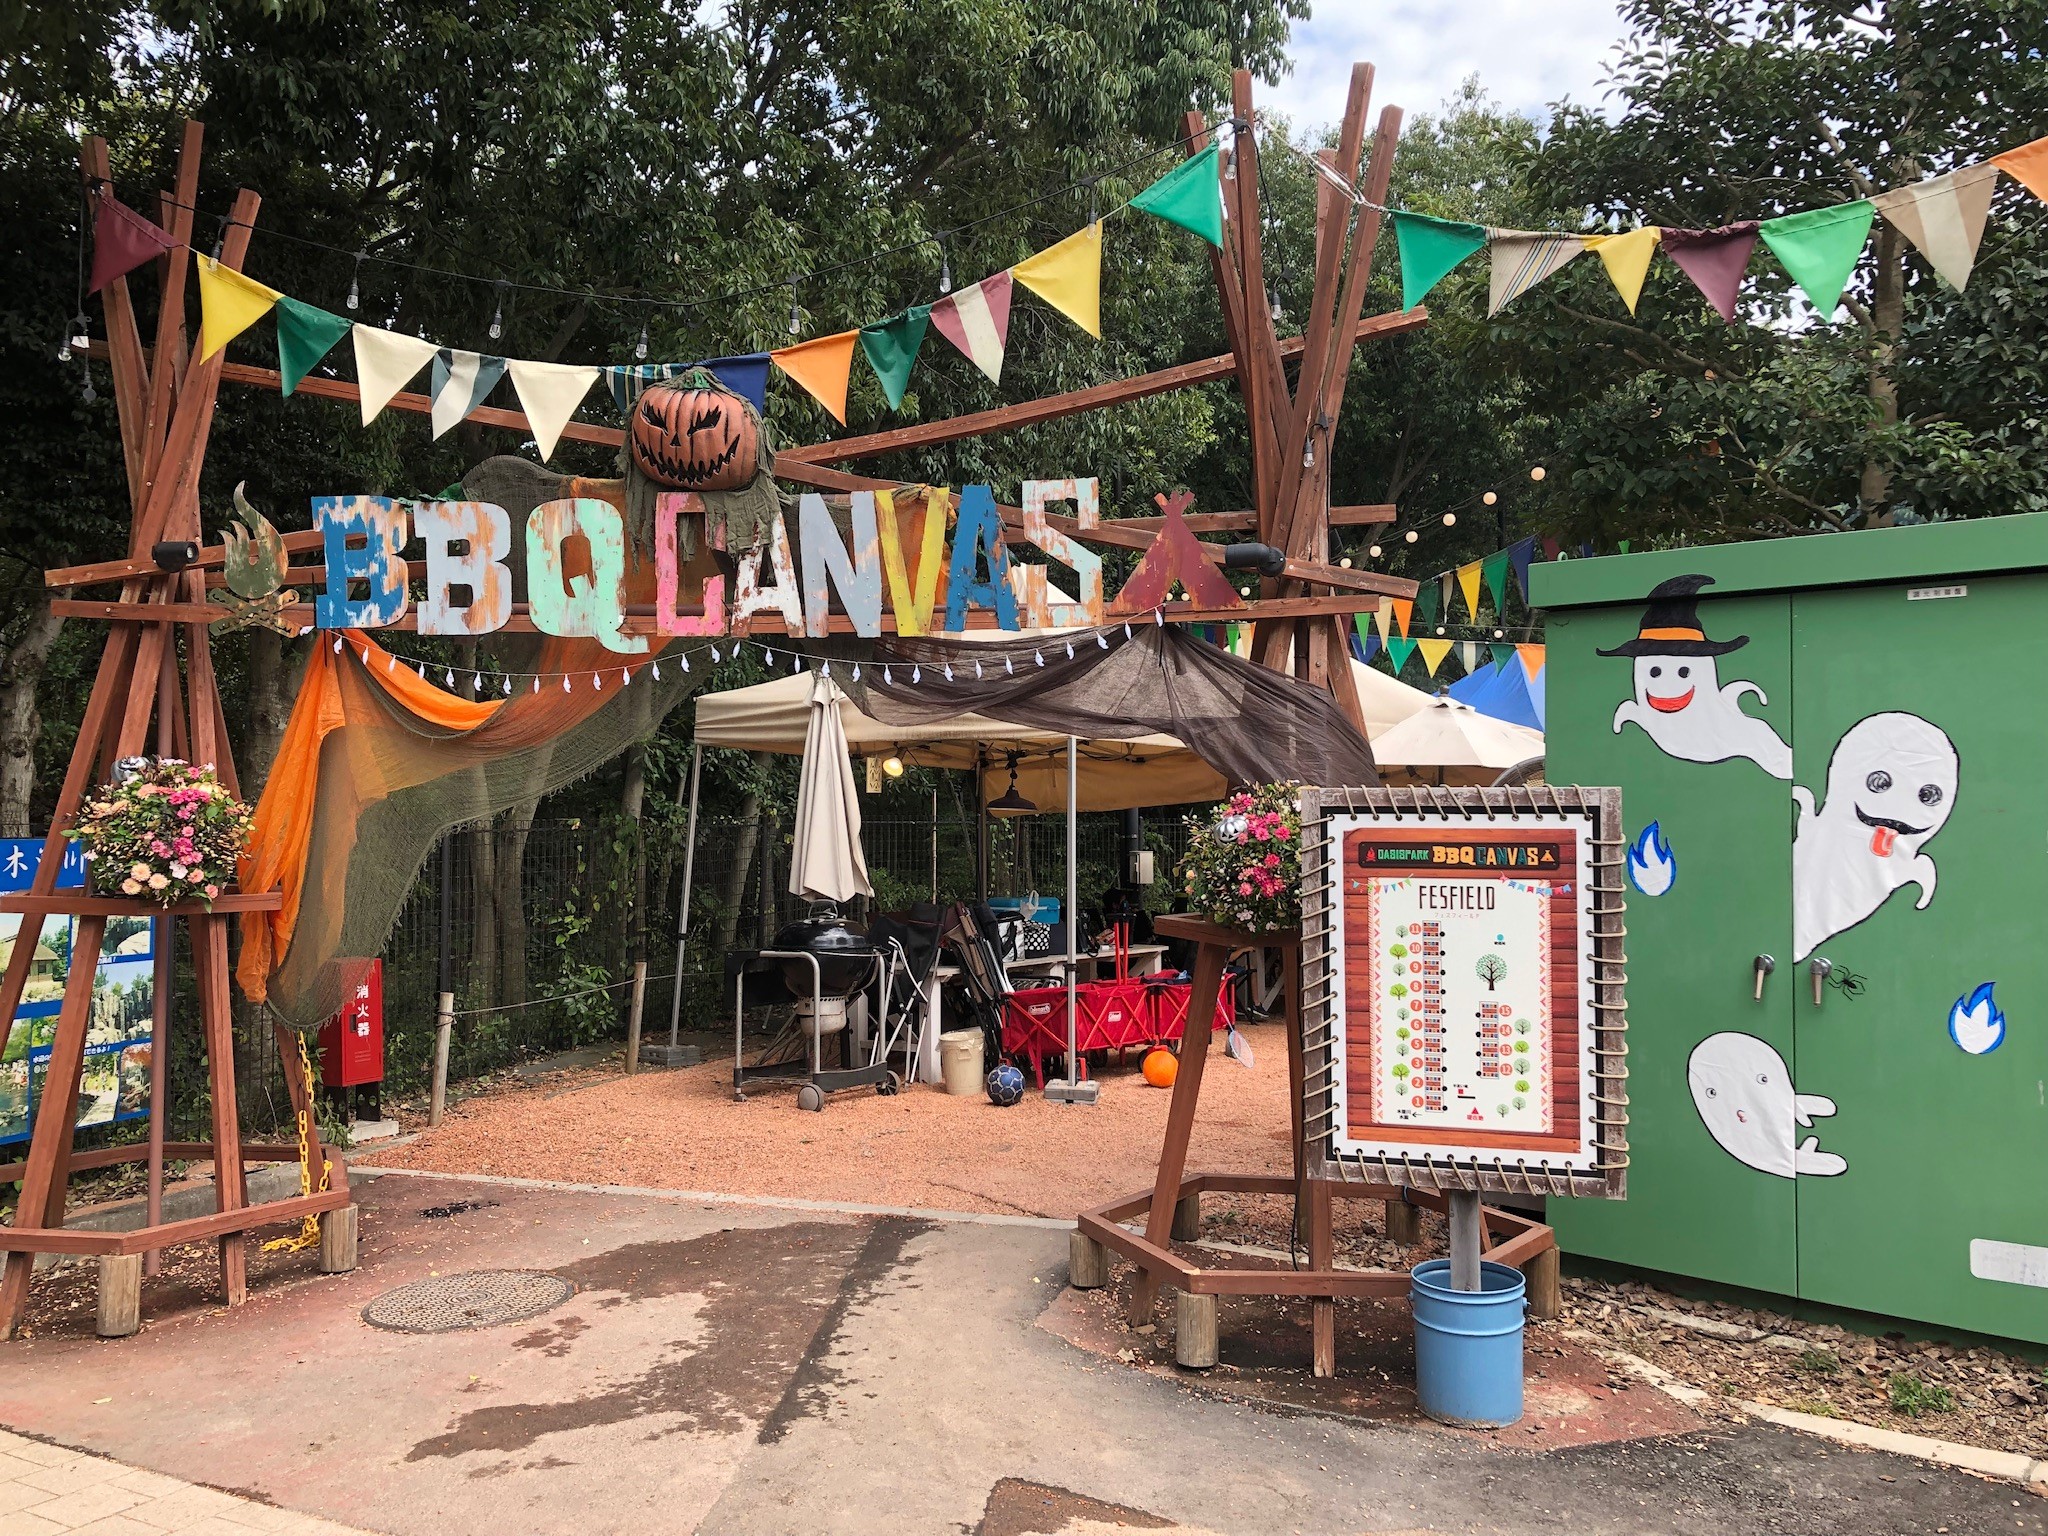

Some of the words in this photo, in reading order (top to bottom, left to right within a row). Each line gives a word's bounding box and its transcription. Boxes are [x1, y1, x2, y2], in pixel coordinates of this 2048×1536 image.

[1418, 885, 1496, 910] FESFIELD
[356, 984, 370, 1037] 消火器
